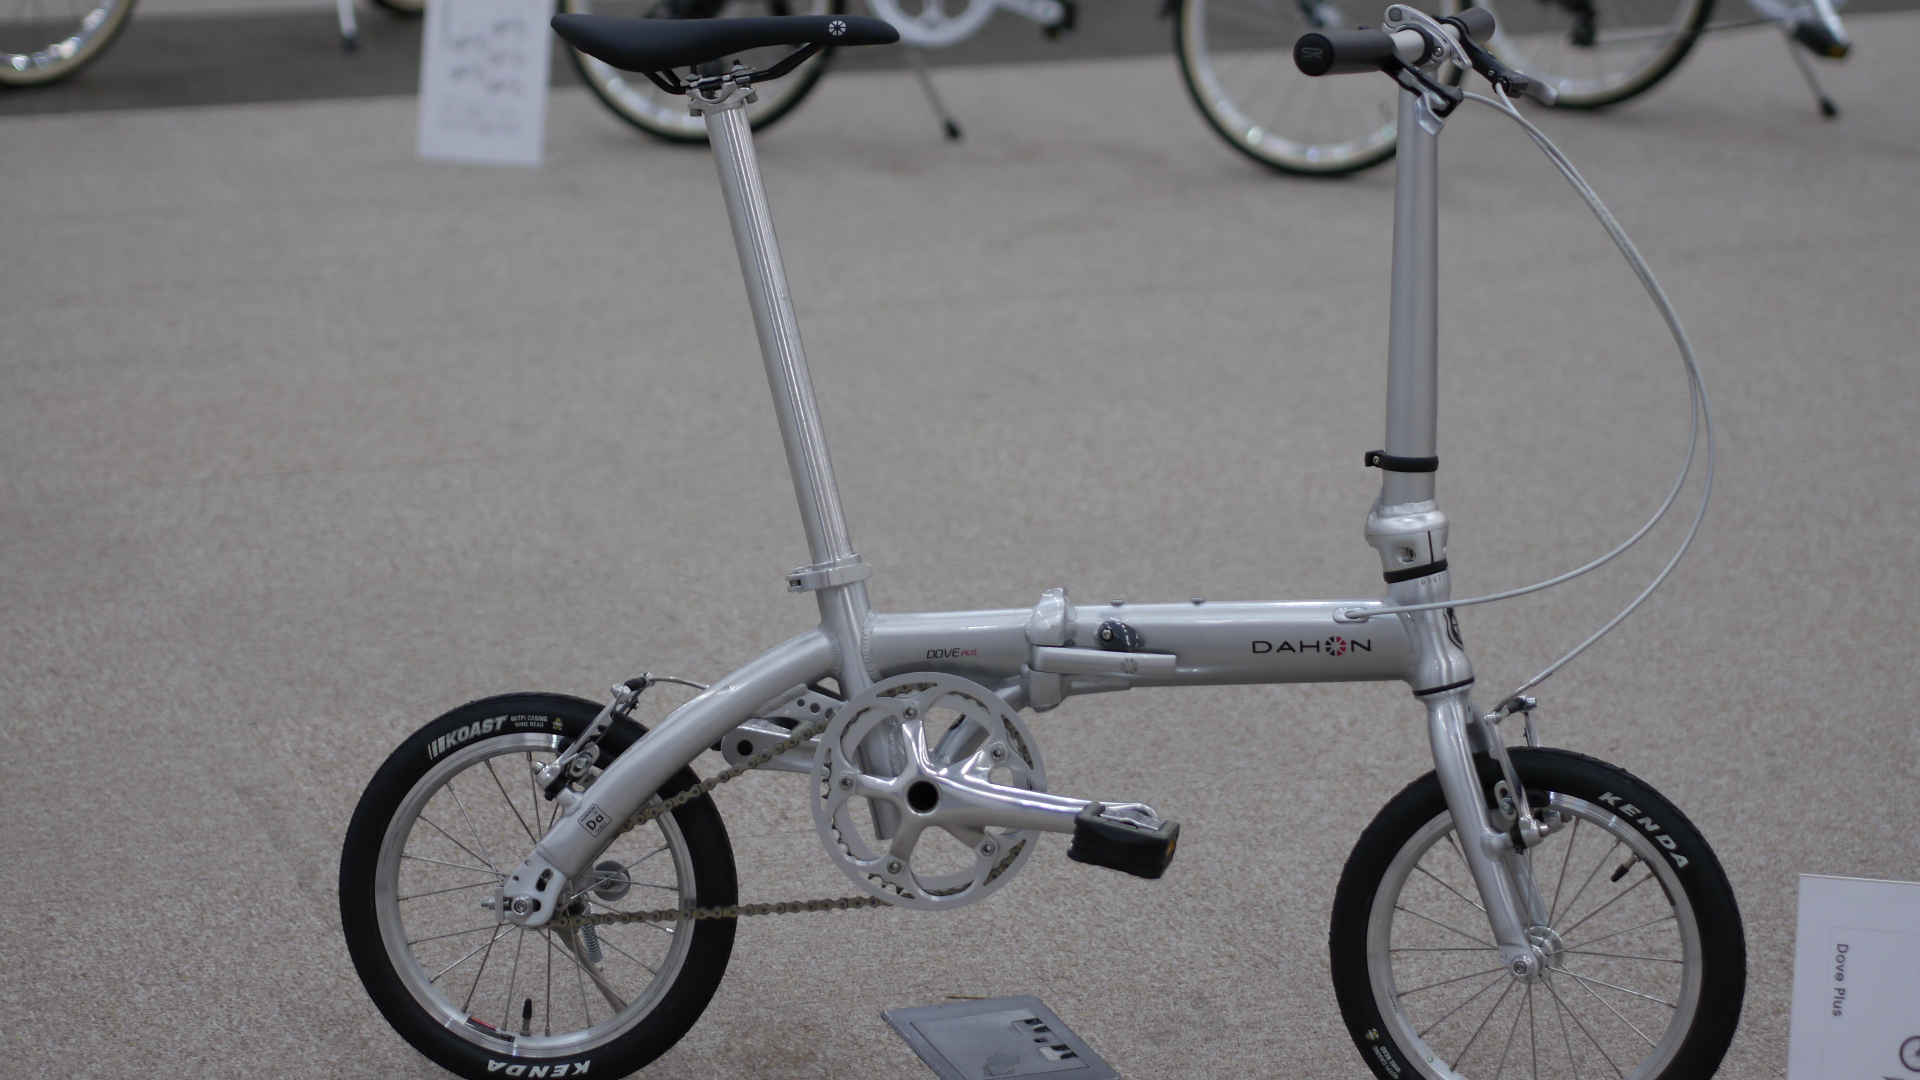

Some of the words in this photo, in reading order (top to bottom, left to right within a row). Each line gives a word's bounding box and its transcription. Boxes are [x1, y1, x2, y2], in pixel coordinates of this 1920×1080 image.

[927, 648, 960, 659] DOVE
[961, 649, 978, 657] PLUS
[1252, 636, 1371, 656] DAHON
[527, 714, 548, 722] CASING
[445, 715, 508, 749] KOAST
[586, 814, 604, 830] Da
[1598, 791, 1689, 868] KENDA
[1834, 943, 1849, 982] Dove
[1832, 987, 1846, 1017] Plus
[487, 1059, 591, 1078] KENDA
